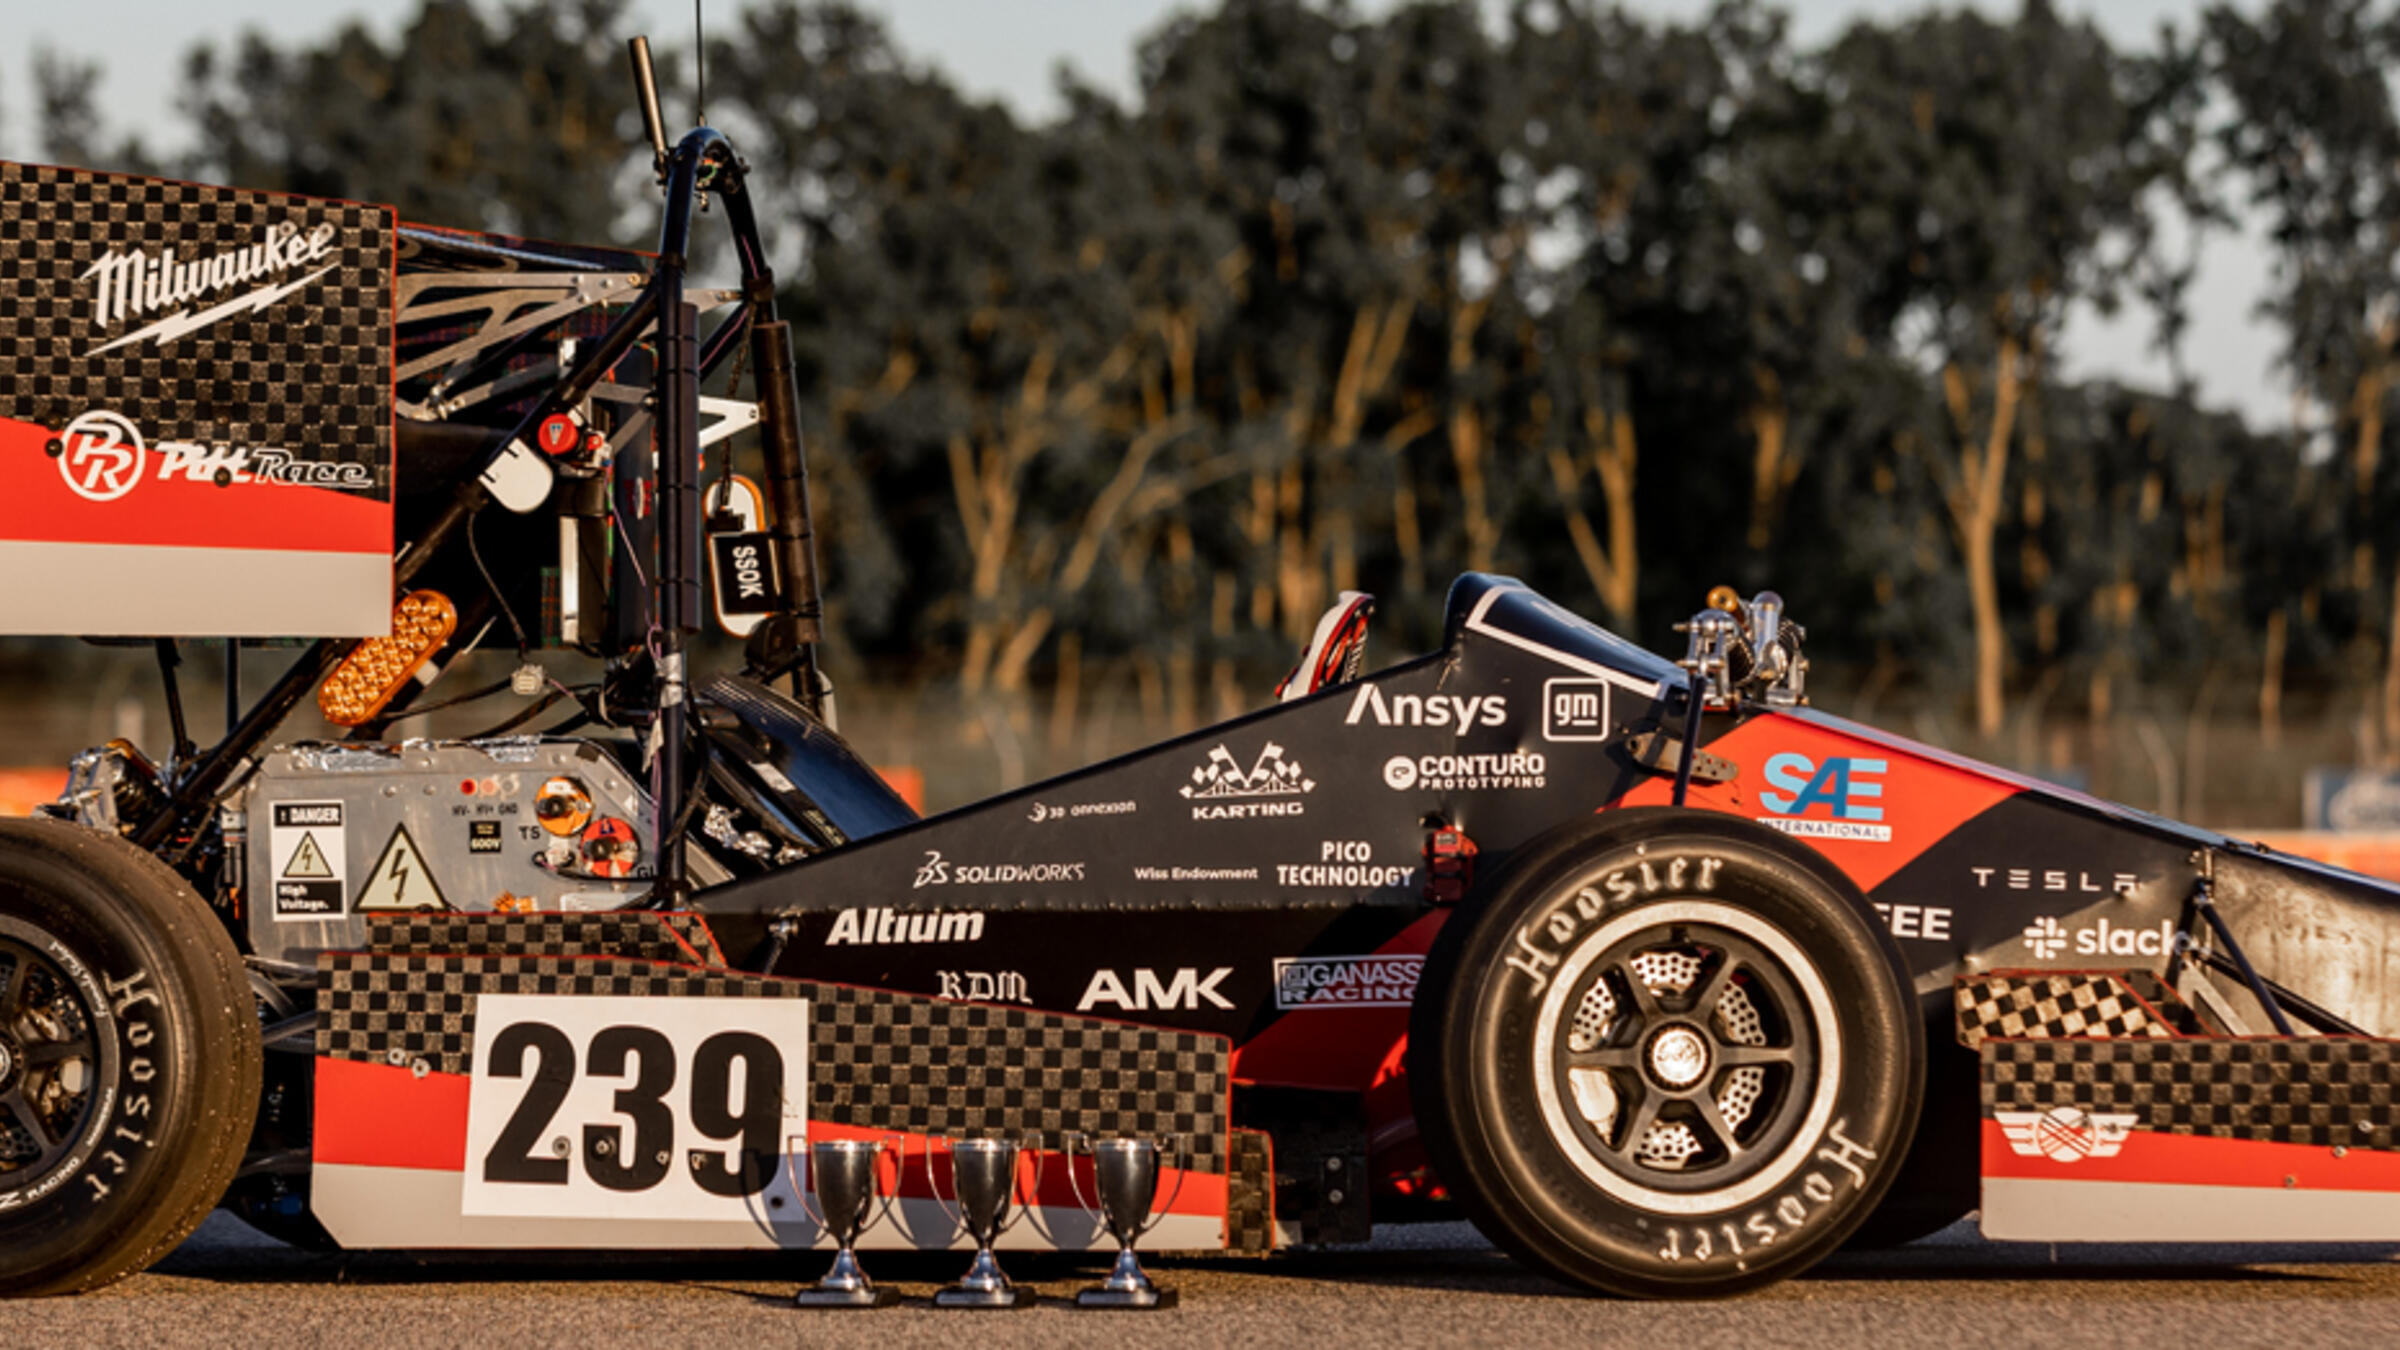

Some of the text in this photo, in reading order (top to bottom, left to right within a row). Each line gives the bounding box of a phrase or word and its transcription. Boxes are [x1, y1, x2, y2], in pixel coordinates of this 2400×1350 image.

[80, 221, 335, 328] Milwaukee
[732, 546, 765, 599] SSOK
[1345, 683, 1507, 736] Ansys
[1554, 693, 1599, 726] gm
[1419, 754, 1546, 777] CONTURO
[1419, 776, 1546, 790] PROTOTYPING
[1759, 752, 1888, 821] SAE
[290, 807, 340, 824] DANGER
[1192, 802, 1304, 820] KARTING
[518, 825, 541, 840] TS
[1762, 819, 1883, 839] NTERNATIONAL
[1321, 841, 1371, 863] PICO
[954, 863, 1085, 884] SOLIDWORKS
[1171, 865, 1258, 880] Endowment
[1277, 864, 1415, 887] TECHNOLOGY
[1971, 868, 2137, 892] TESLA
[825, 907, 986, 946] Altium
[1505, 843, 1724, 998] Hoosier
[1310, 961, 1425, 987] GANASS
[1075, 967, 1236, 1012] AMK
[483, 1021, 785, 1198] 239
[1657, 1118, 1877, 1271] Hoosier
